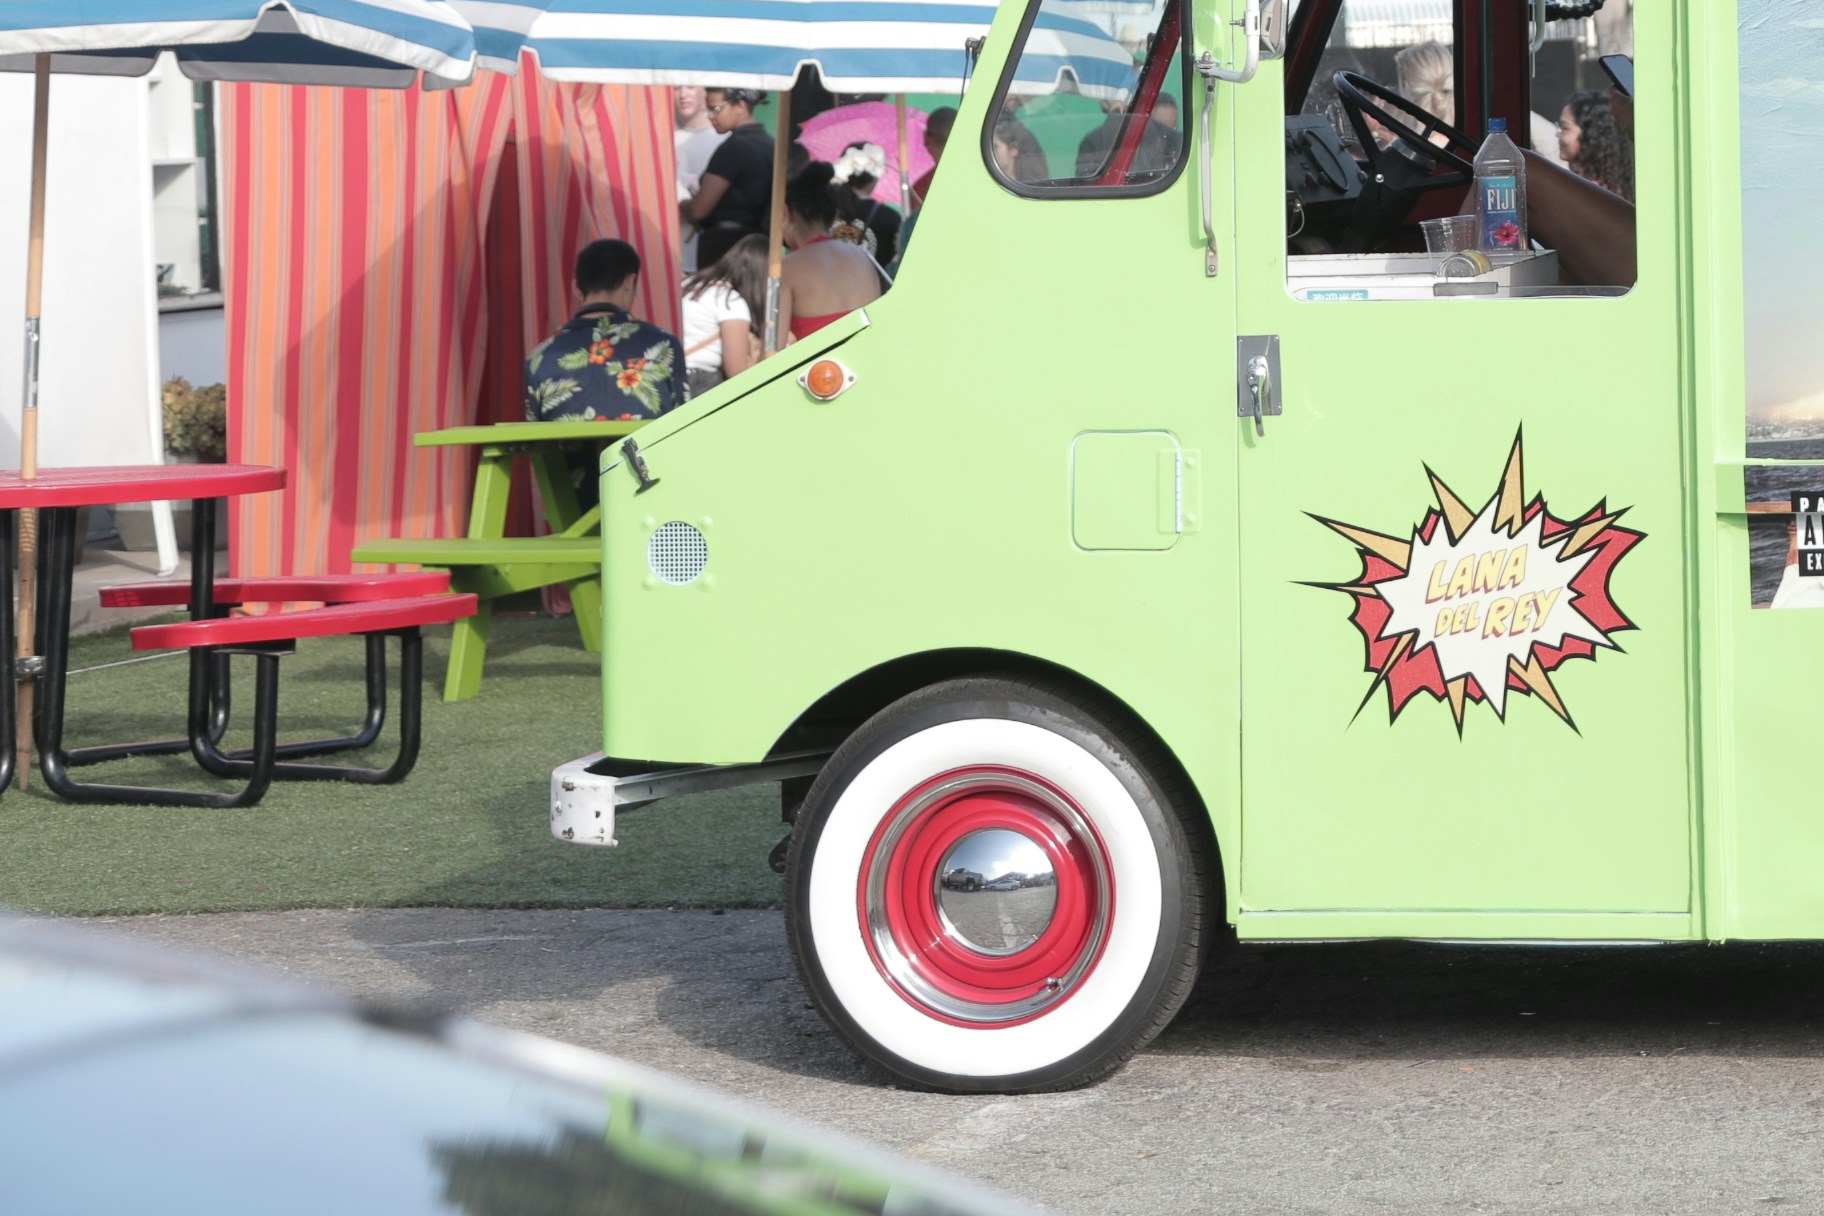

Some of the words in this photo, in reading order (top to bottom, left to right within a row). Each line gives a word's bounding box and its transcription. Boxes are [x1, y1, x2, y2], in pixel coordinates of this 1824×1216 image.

[1487, 188, 1517, 211] FIJI
[1425, 543, 1529, 604] LANA
[1433, 603, 1480, 638] DEL
[1481, 586, 1563, 640] REY
